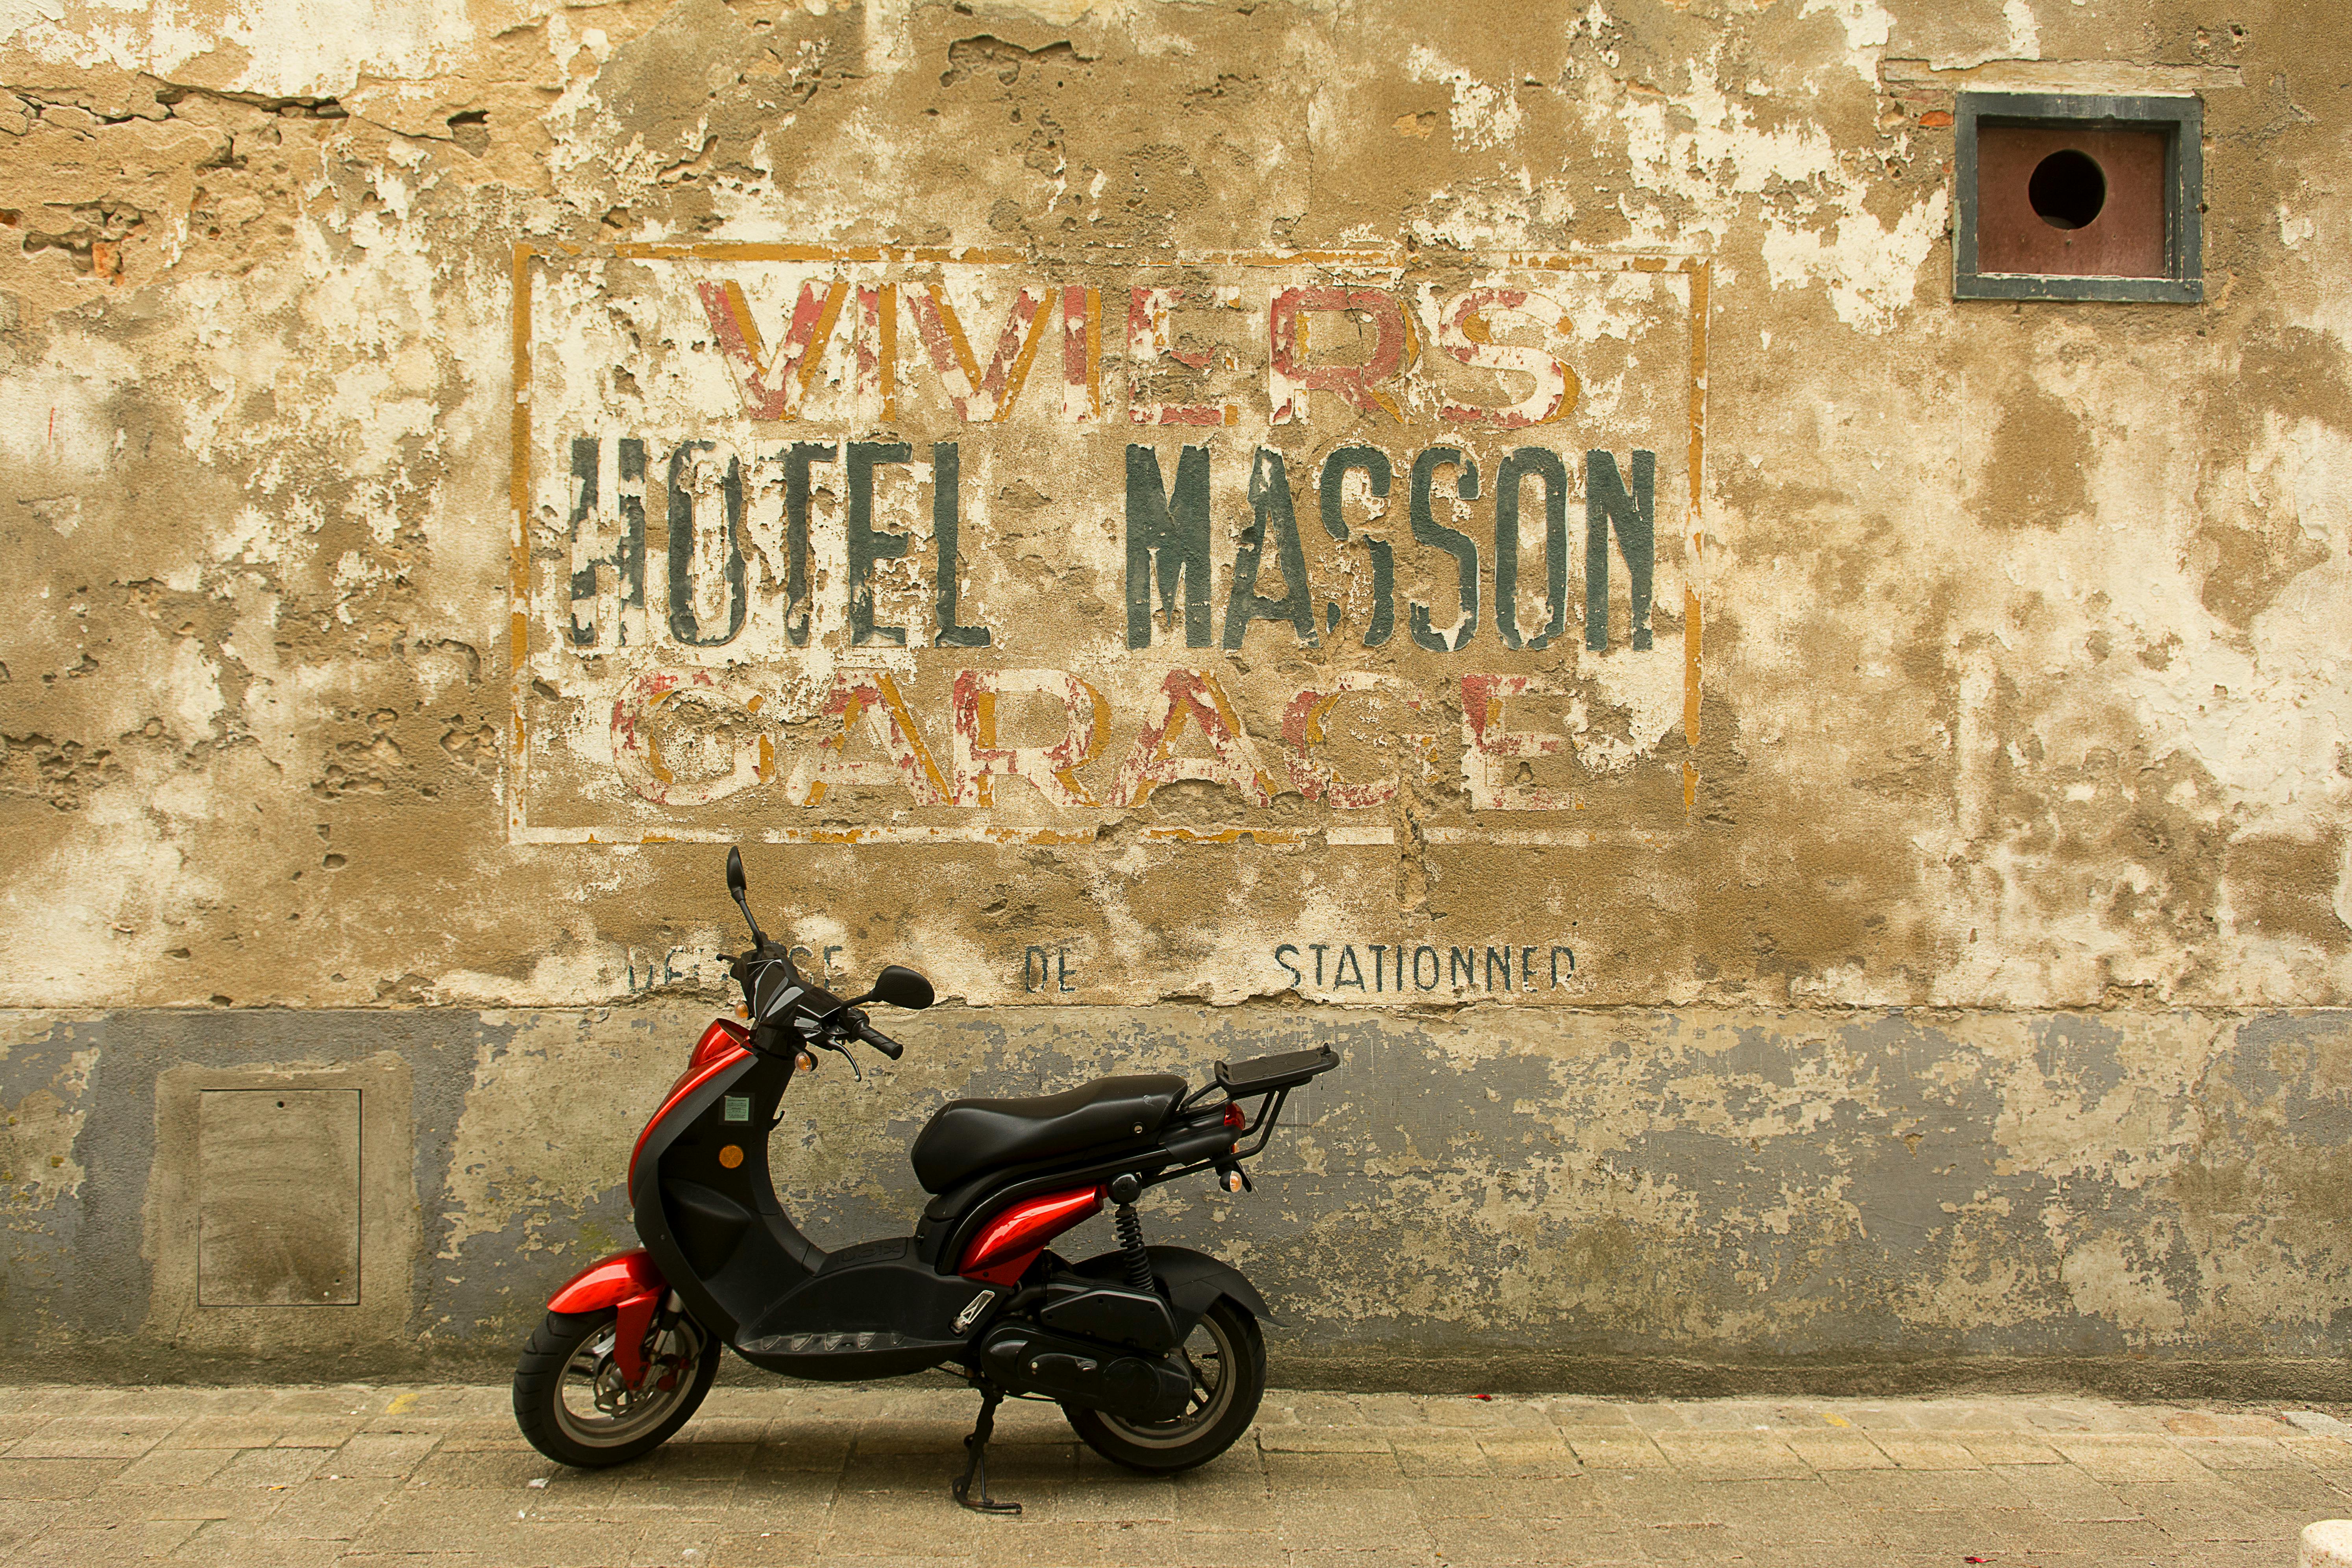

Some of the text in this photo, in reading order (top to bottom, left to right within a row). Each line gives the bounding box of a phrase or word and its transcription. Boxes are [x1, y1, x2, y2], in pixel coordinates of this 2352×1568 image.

[697, 279, 1581, 430] VIVIERS
[571, 438, 1655, 652] HOTEL MASSON
[611, 666, 1584, 812] GARAGE
[1025, 945, 1077, 993] DE
[1274, 945, 1577, 993] STATIONNER
